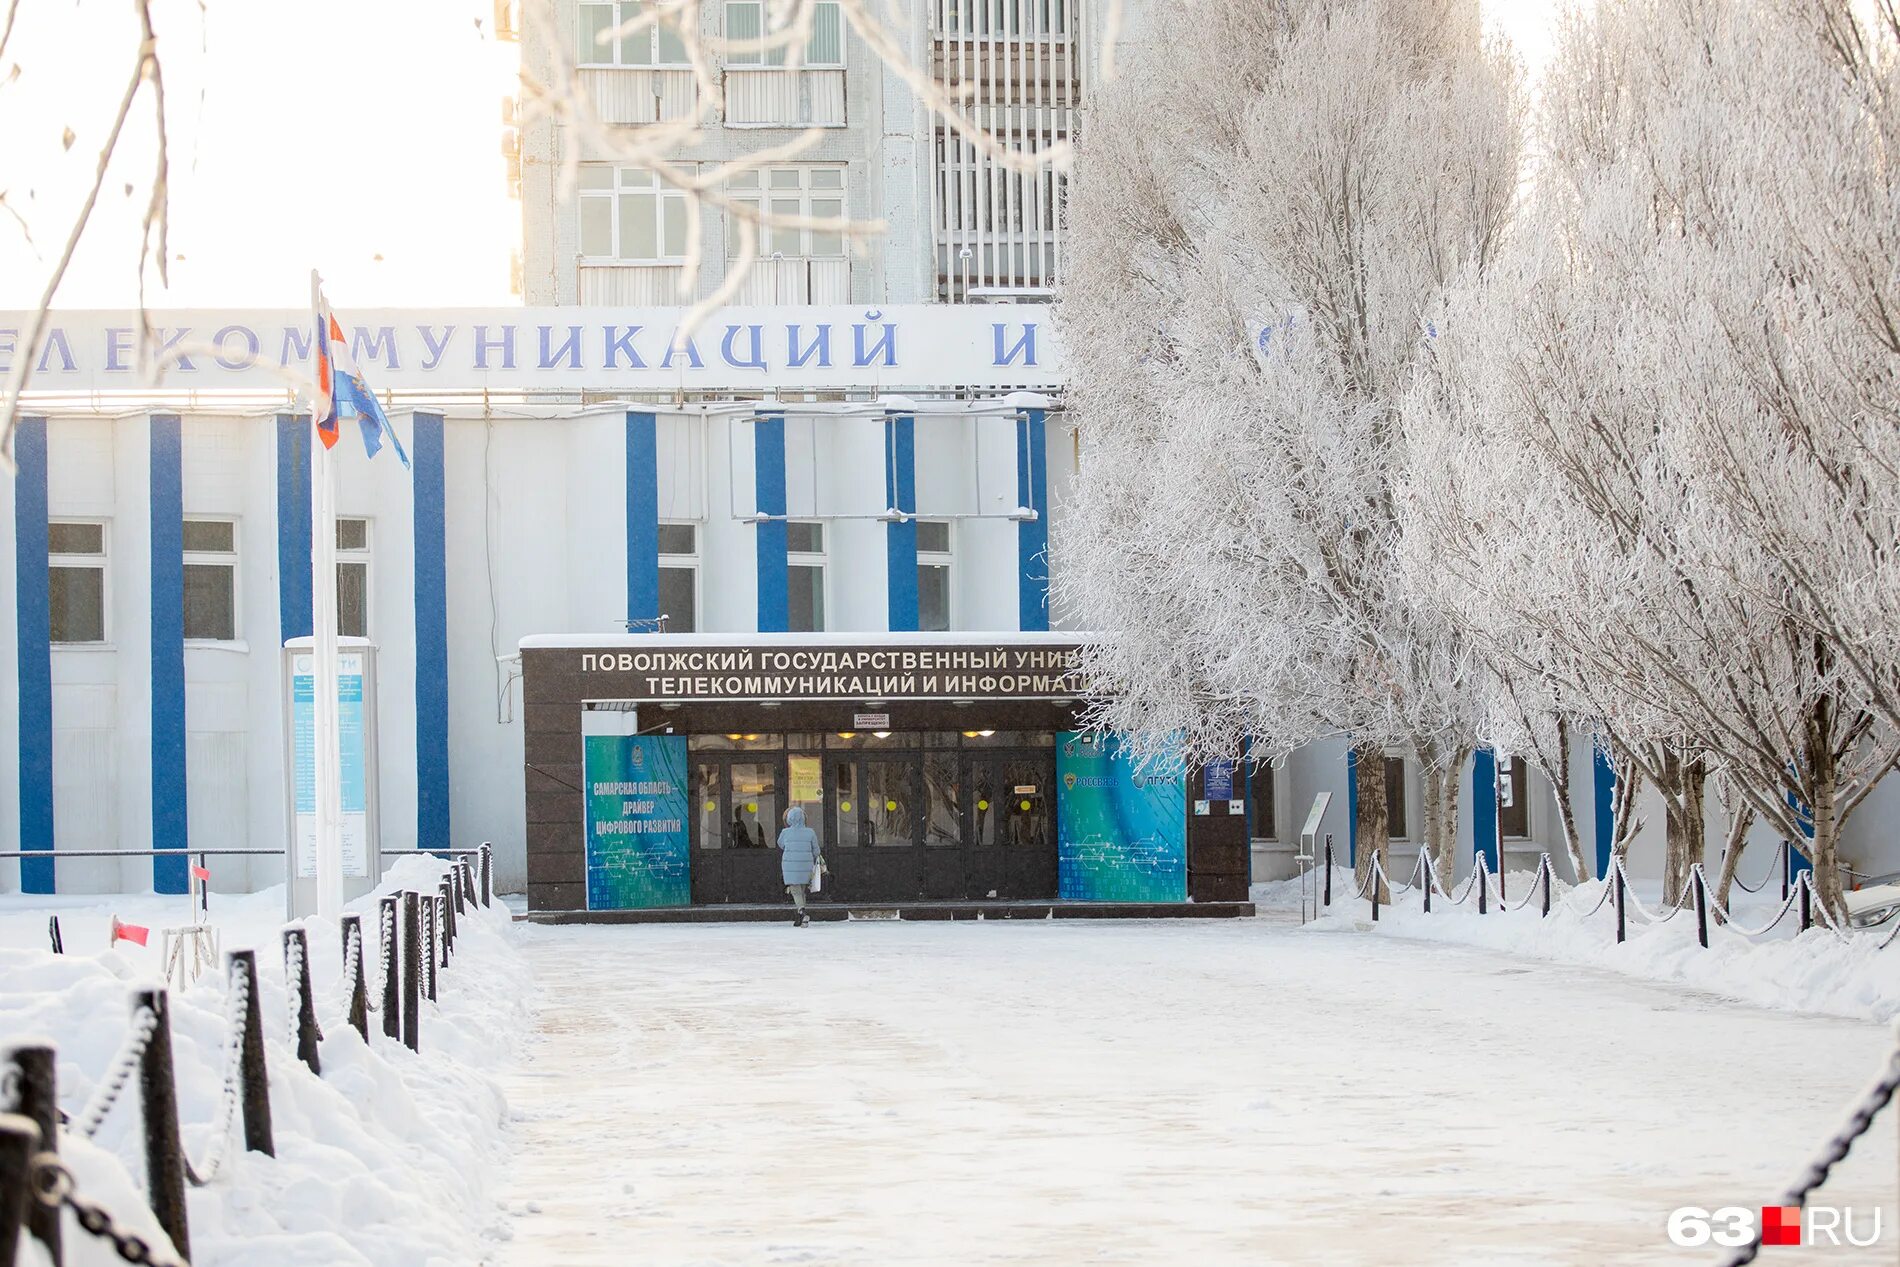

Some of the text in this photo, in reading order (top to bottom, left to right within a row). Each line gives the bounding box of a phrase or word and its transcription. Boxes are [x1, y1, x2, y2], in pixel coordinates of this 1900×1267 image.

[991, 322, 1039, 367] И
[582, 649, 753, 672] ПОВОЛЖСКИЙ
[762, 648, 1007, 671] ГОСУДАРСТВЕННЫЙ
[646, 672, 915, 694] ТЕЛЕКОММУНИКАЦИЙ
[924, 675, 937, 693] И
[594, 783, 637, 795] САМАРСКАЯ
[639, 782, 670, 794] ОБЛАСТЬ
[1076, 777, 1119, 787] РОССВЯЗЬ
[1147, 776, 1178, 785] ПГУТИ
[623, 799, 654, 816] ДРАЙВЕР
[596, 820, 680, 835] ЦИФРОВОГО РАЗВИТИЯ
